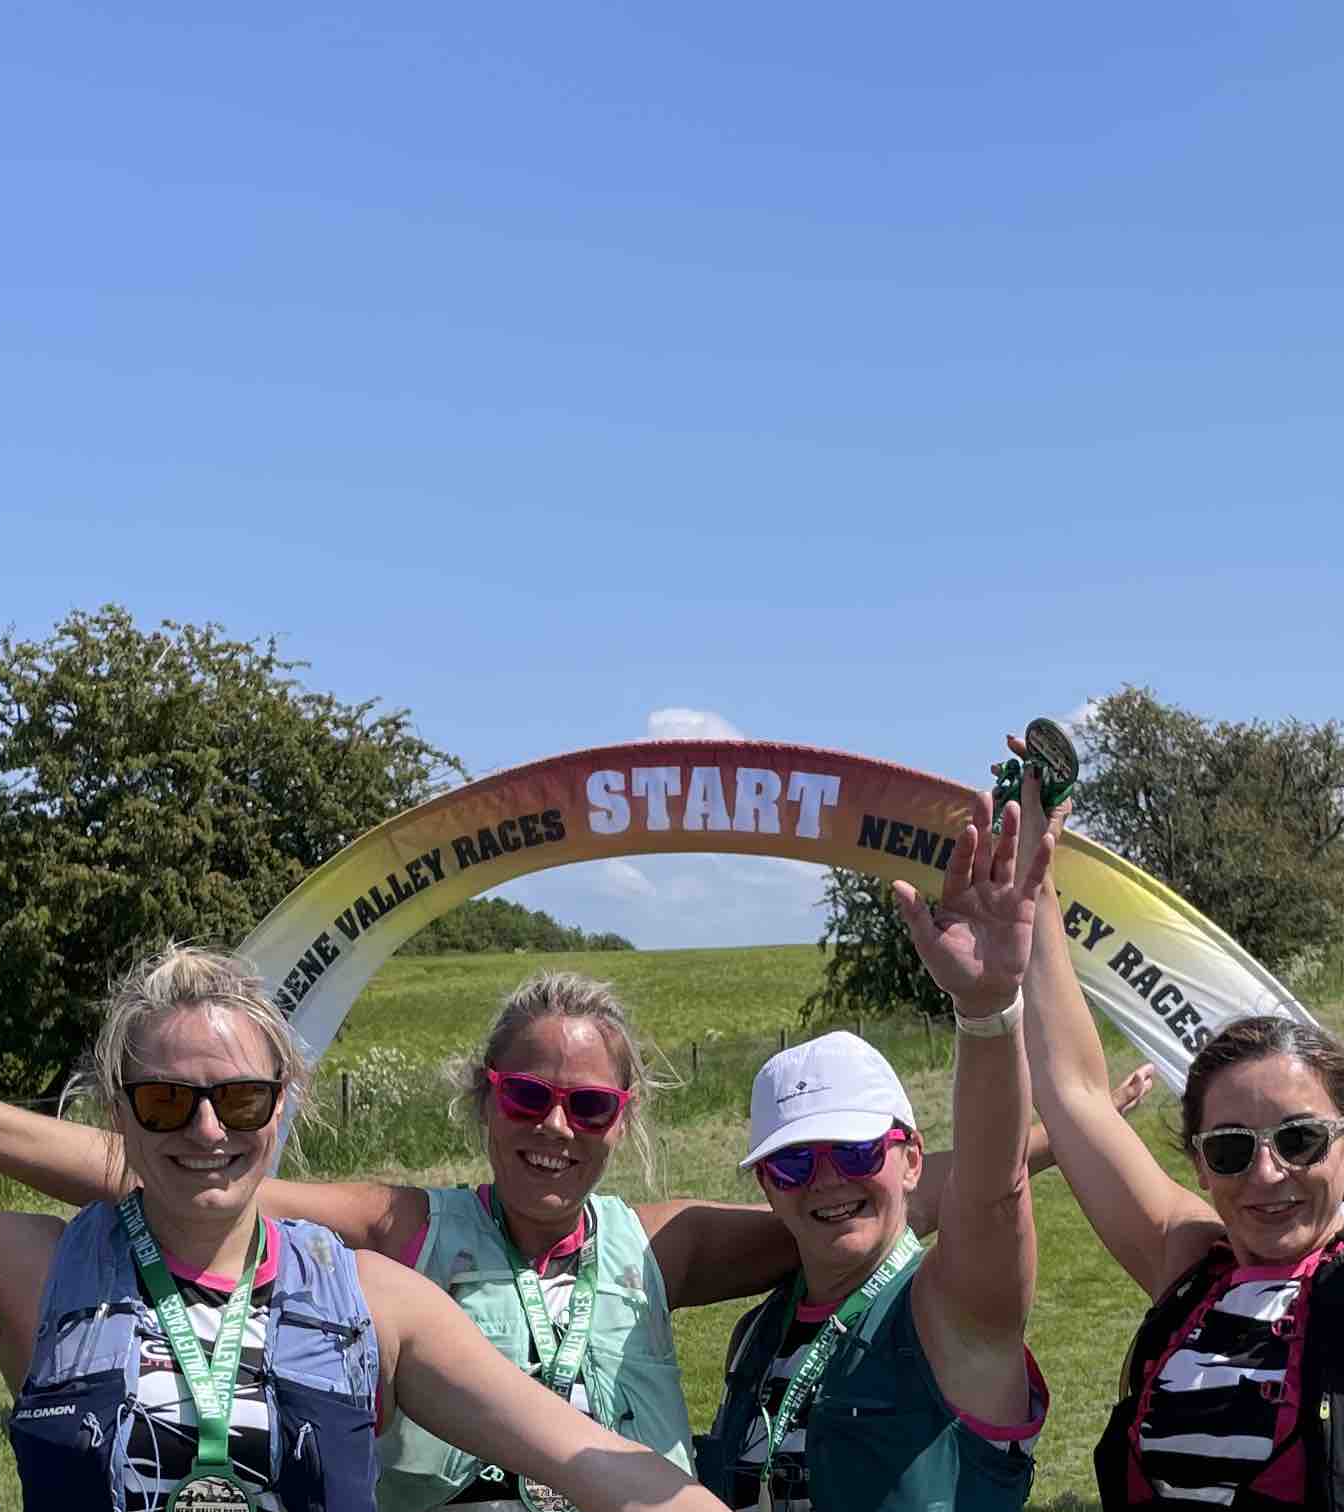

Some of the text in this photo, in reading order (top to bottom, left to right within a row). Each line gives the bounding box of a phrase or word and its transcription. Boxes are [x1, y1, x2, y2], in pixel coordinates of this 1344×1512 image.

[586, 766, 841, 840] START
[275, 809, 567, 1021] NENE VALLEY RACES
[1107, 941, 1215, 1054] RACES
[171, 1335, 208, 1378] VALLEY
[213, 1320, 240, 1368] VALLEY
